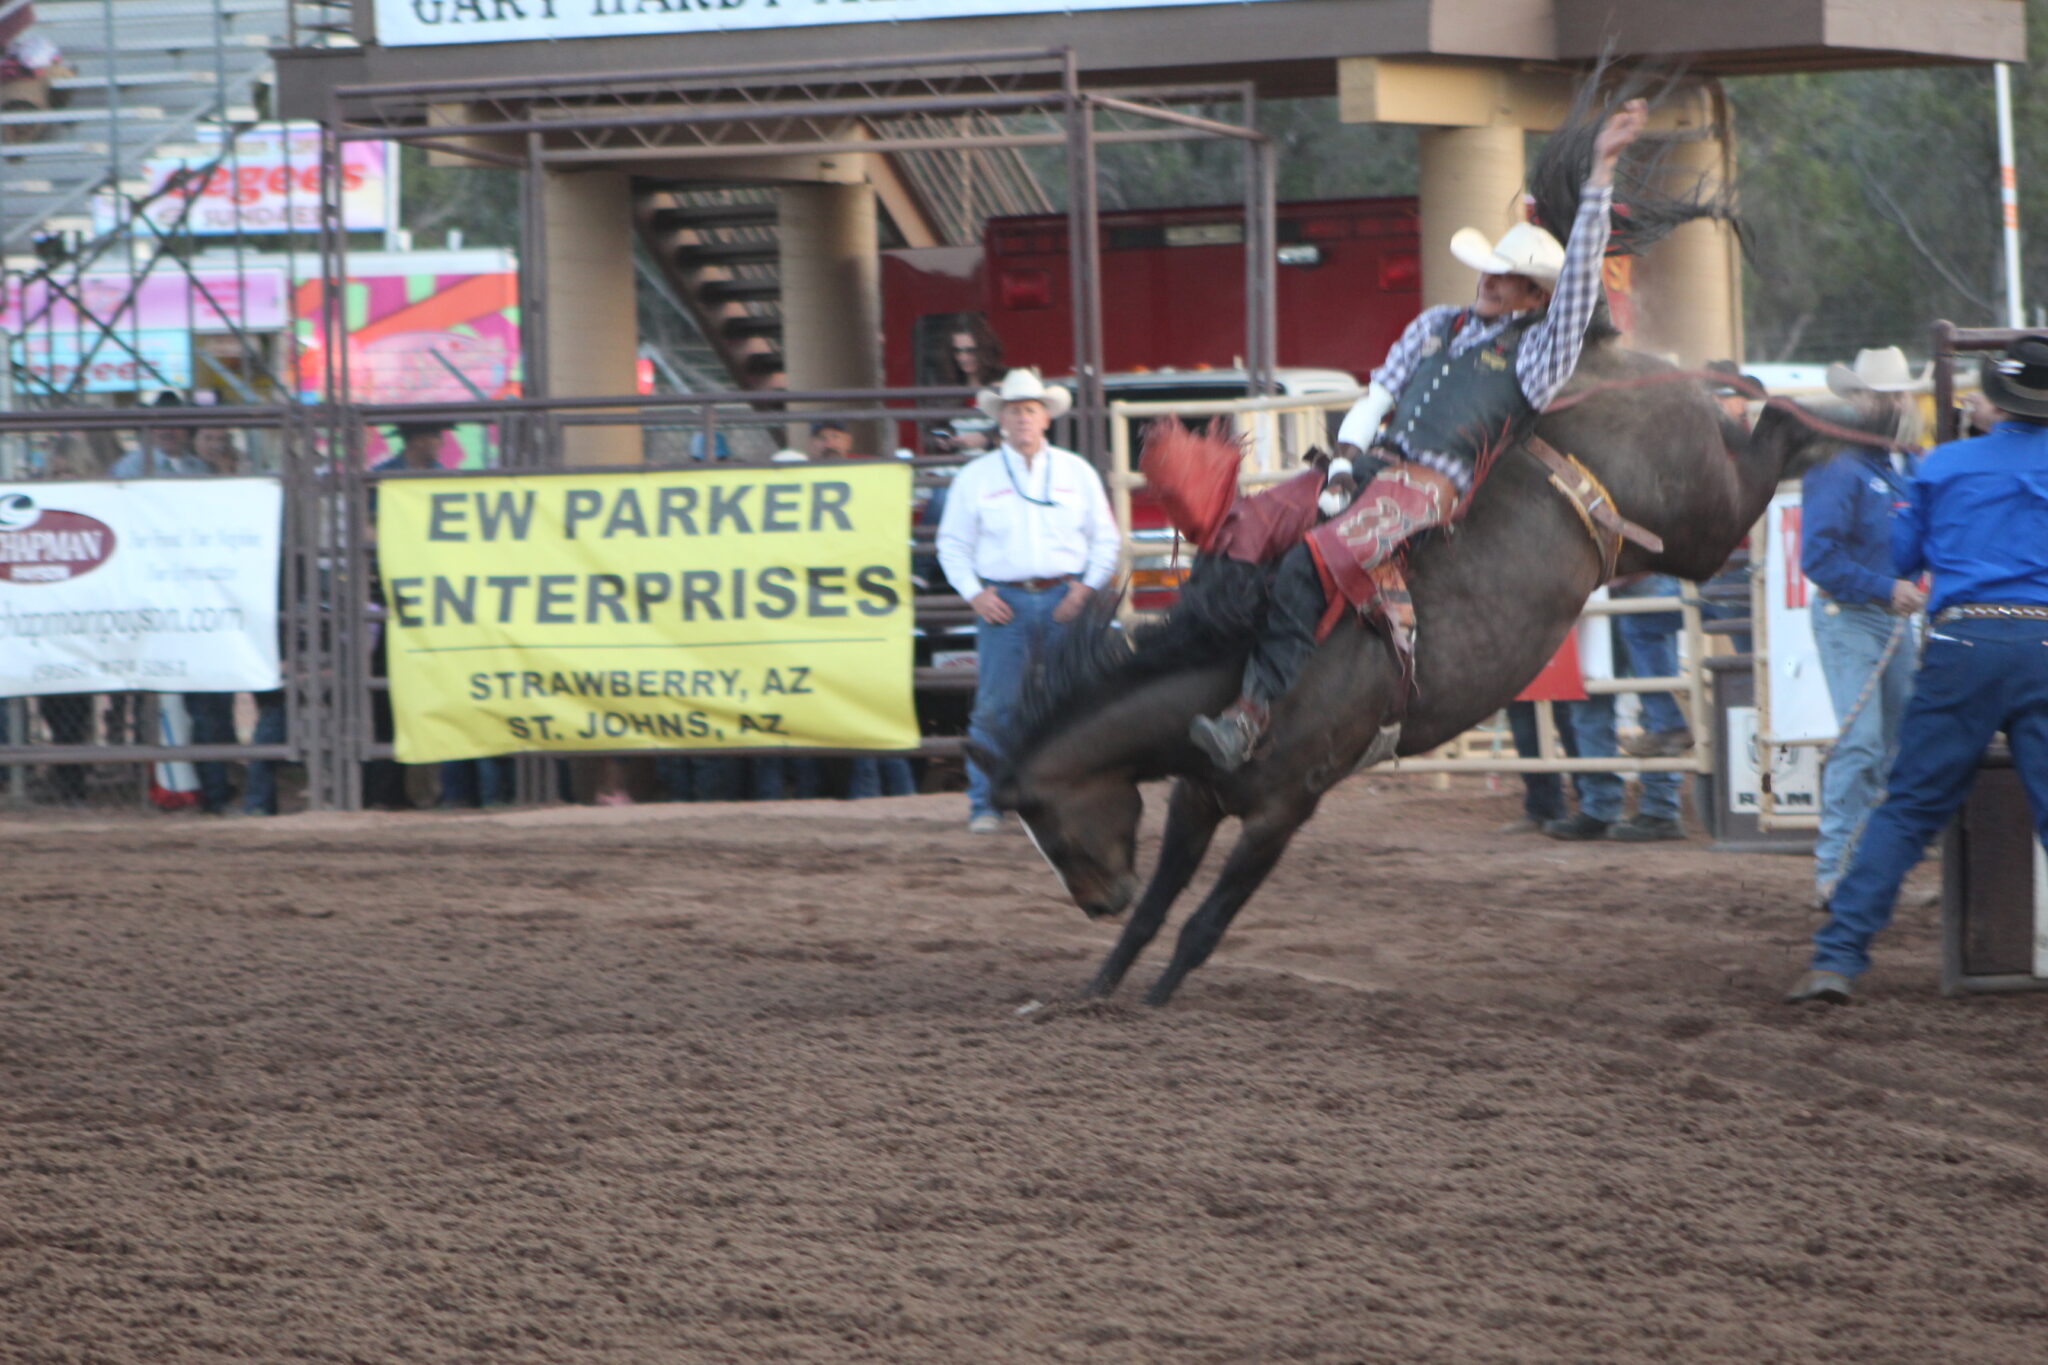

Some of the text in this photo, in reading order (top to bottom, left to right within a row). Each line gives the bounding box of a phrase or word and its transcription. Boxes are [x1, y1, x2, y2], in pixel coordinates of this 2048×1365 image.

[428, 481, 853, 541] EW PARKER
[391, 565, 901, 628] ENTERPRISES
[469, 667, 813, 702] STRAWBERRY, AZ
[506, 711, 788, 741] ST. JOHNS, AZ
